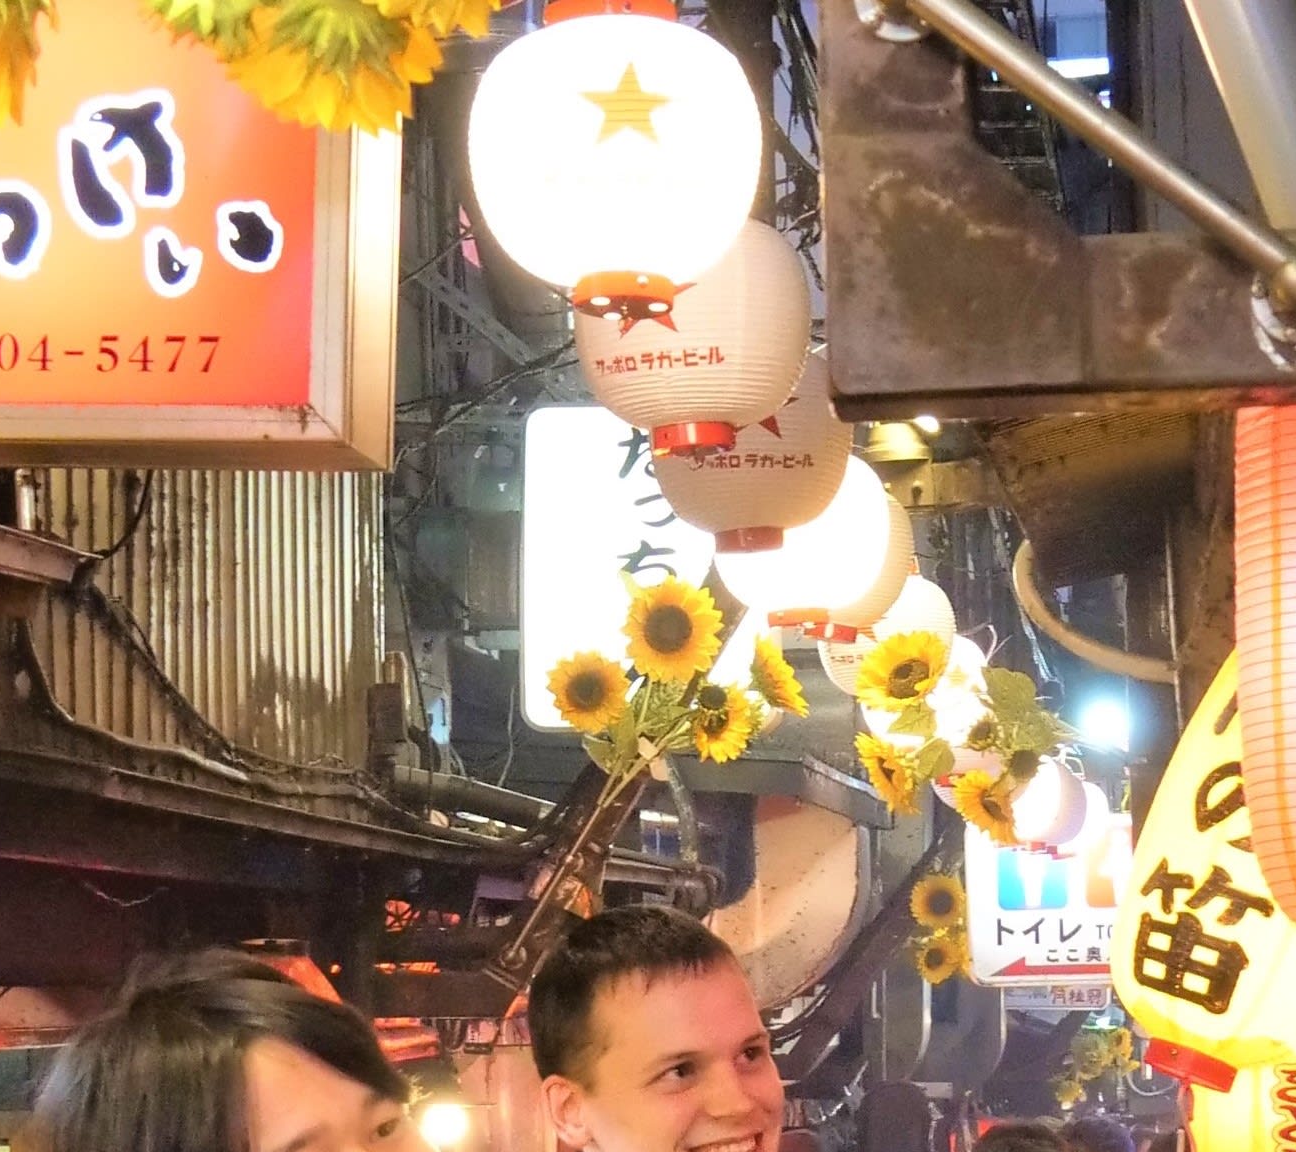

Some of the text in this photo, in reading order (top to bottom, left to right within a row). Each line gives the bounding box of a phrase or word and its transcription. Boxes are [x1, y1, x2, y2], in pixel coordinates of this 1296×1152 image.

[996, 917, 1082, 946] トイレ
[1045, 945, 1110, 963] ここ奥
